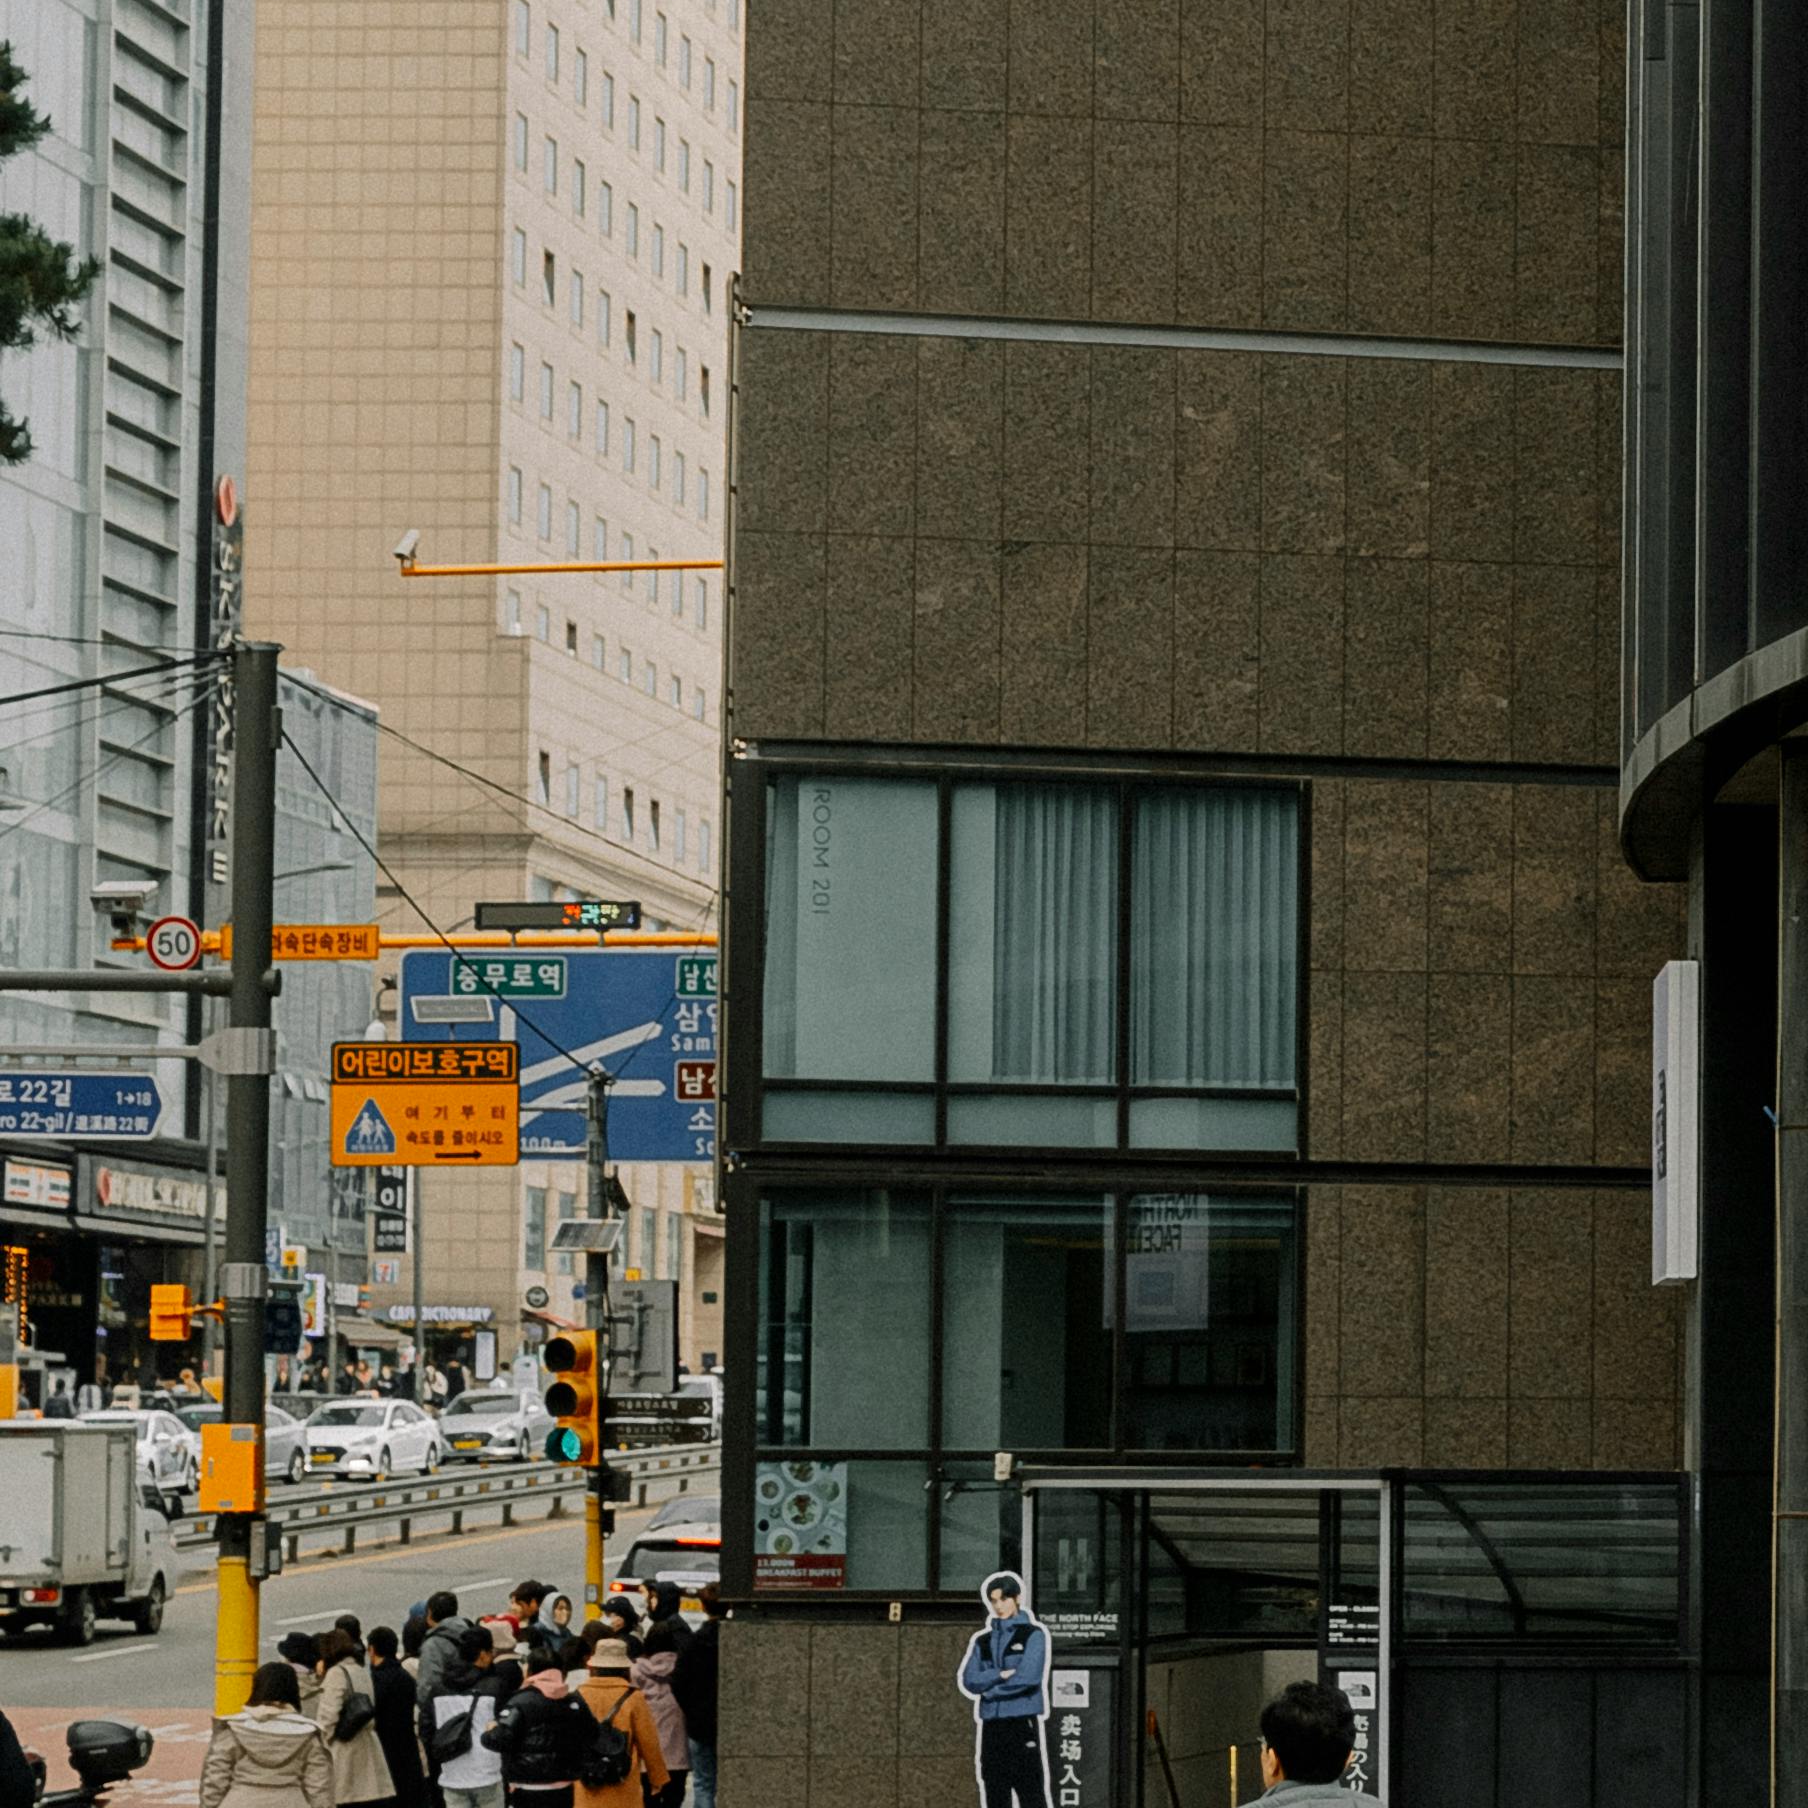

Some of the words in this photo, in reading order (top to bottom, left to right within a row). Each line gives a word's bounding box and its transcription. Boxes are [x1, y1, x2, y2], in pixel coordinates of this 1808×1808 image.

[813, 788, 831, 868] ROOM
[812, 879, 831, 914] 201
[158, 930, 190, 956] 50
[456, 963, 561, 992] 충무로역
[341, 1049, 509, 1077] 어린이보호구역
[1059, 1713, 1082, 1807] 卖场入口
